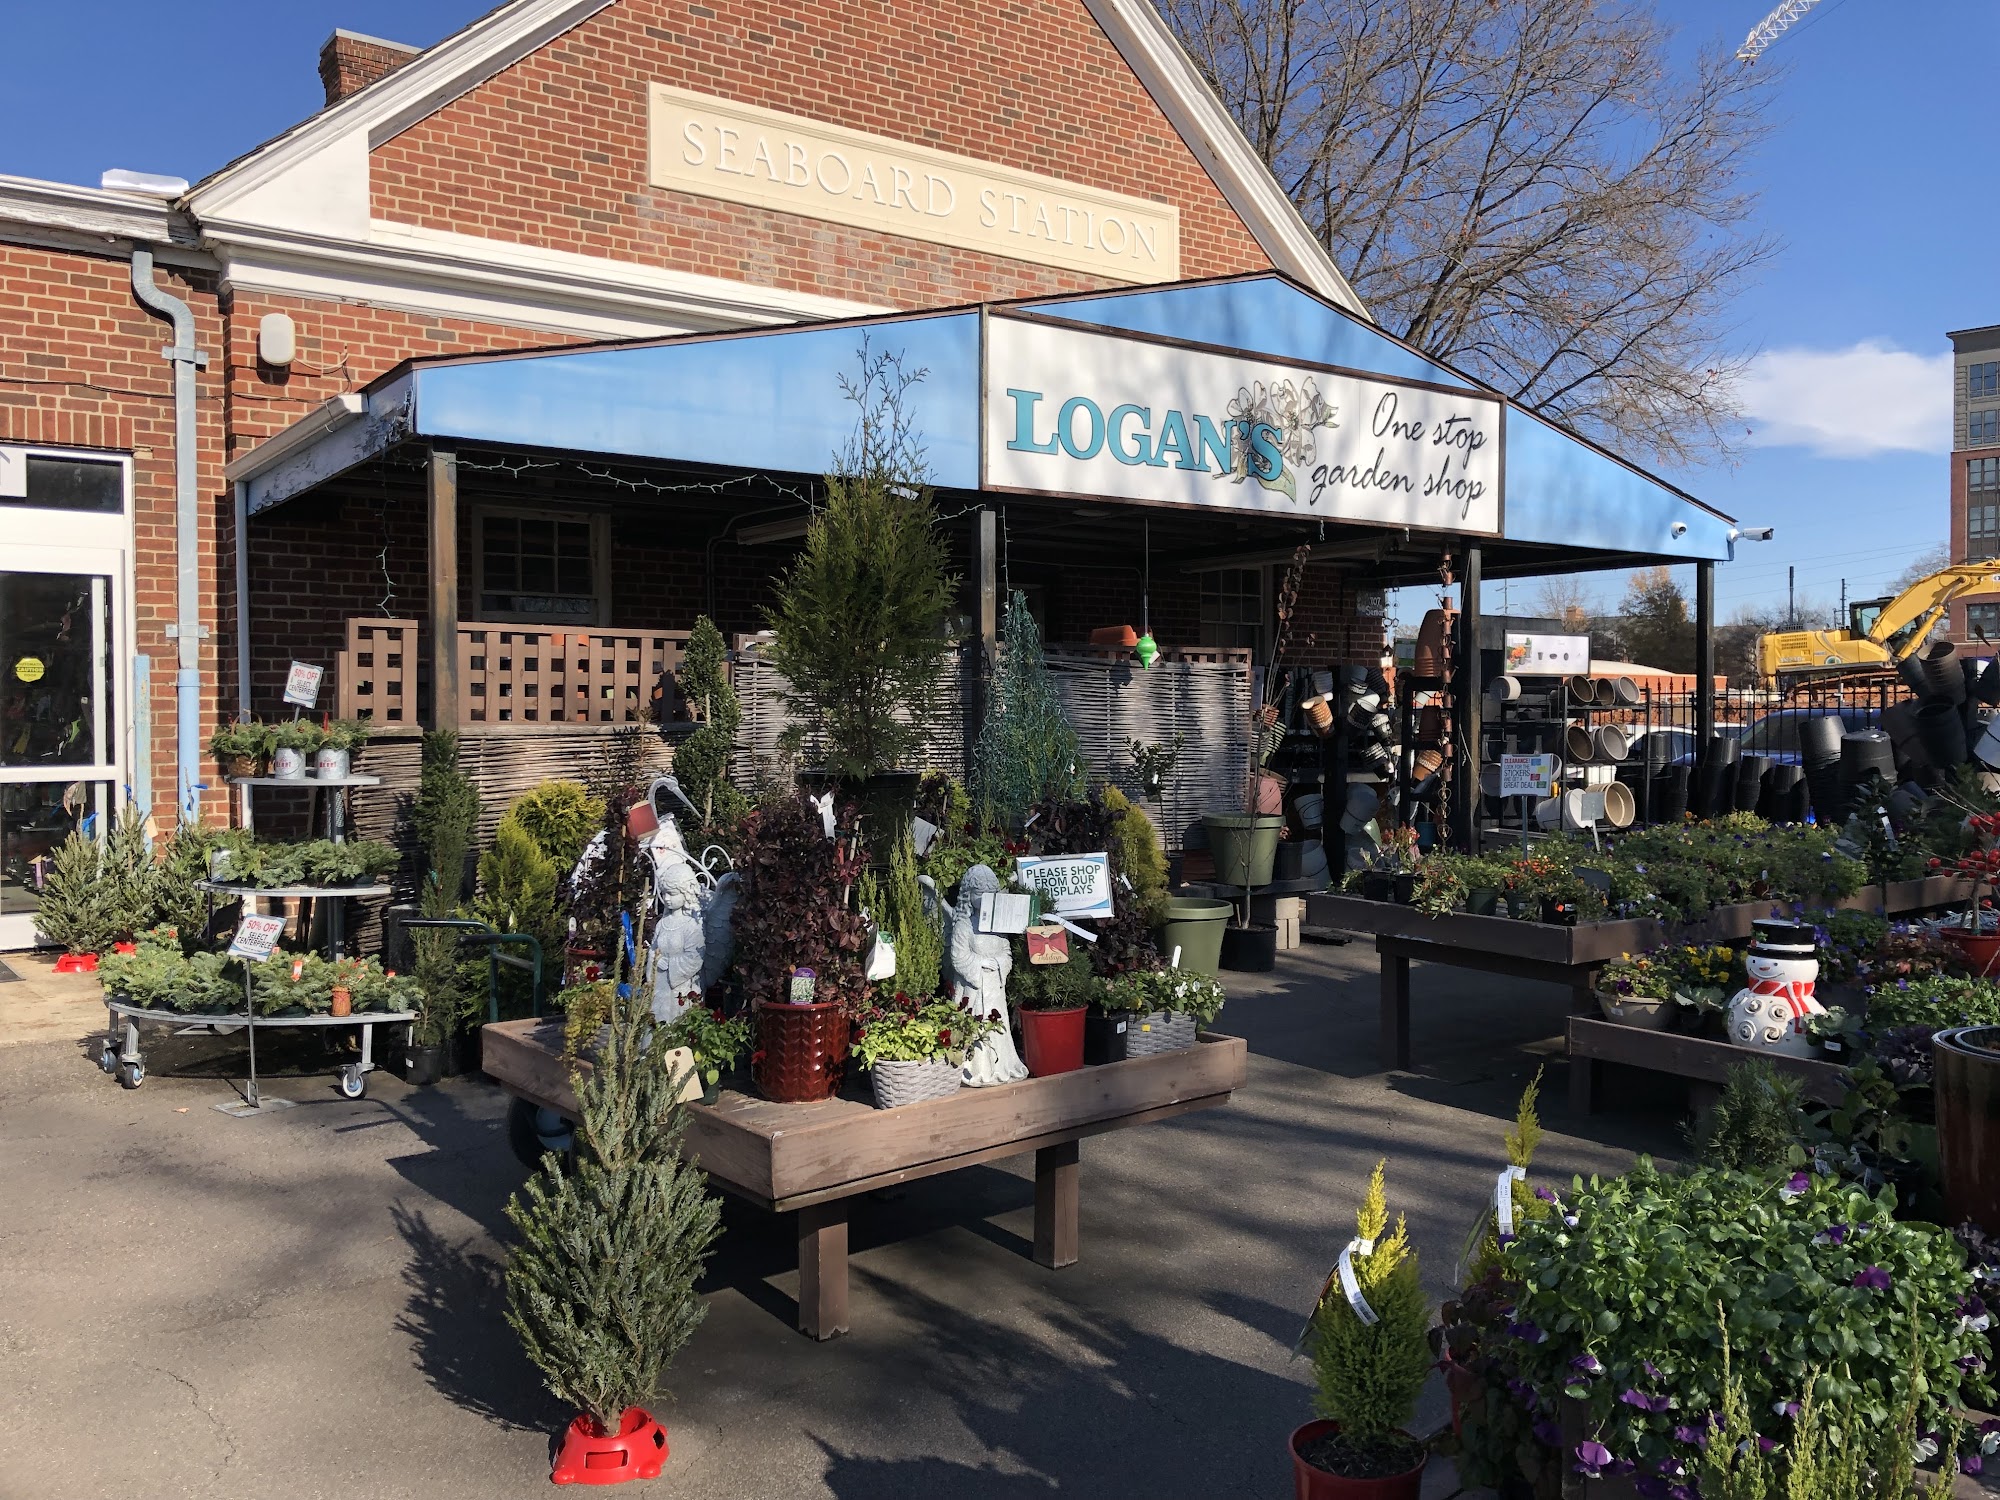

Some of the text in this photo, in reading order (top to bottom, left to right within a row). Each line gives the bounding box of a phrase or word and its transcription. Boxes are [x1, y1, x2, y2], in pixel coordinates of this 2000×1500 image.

[682, 120, 1157, 262] SEABOARD STATION
[1006, 387, 1284, 481] LOGAN'S
[1372, 392, 1488, 470] One stop
[1309, 446, 1487, 521] garden shop
[294, 668, 319, 680] 50% OFF
[1504, 769, 1531, 777] STICKERS
[1504, 781, 1520, 789] GREAT
[1026, 864, 1101, 878] PLEASE SHOP
[1034, 874, 1095, 888] FROM OUR
[246, 920, 279, 933] 50% OFF
[236, 936, 273, 950] CENTERPIECE
[248, 931, 269, 941] SELECT
